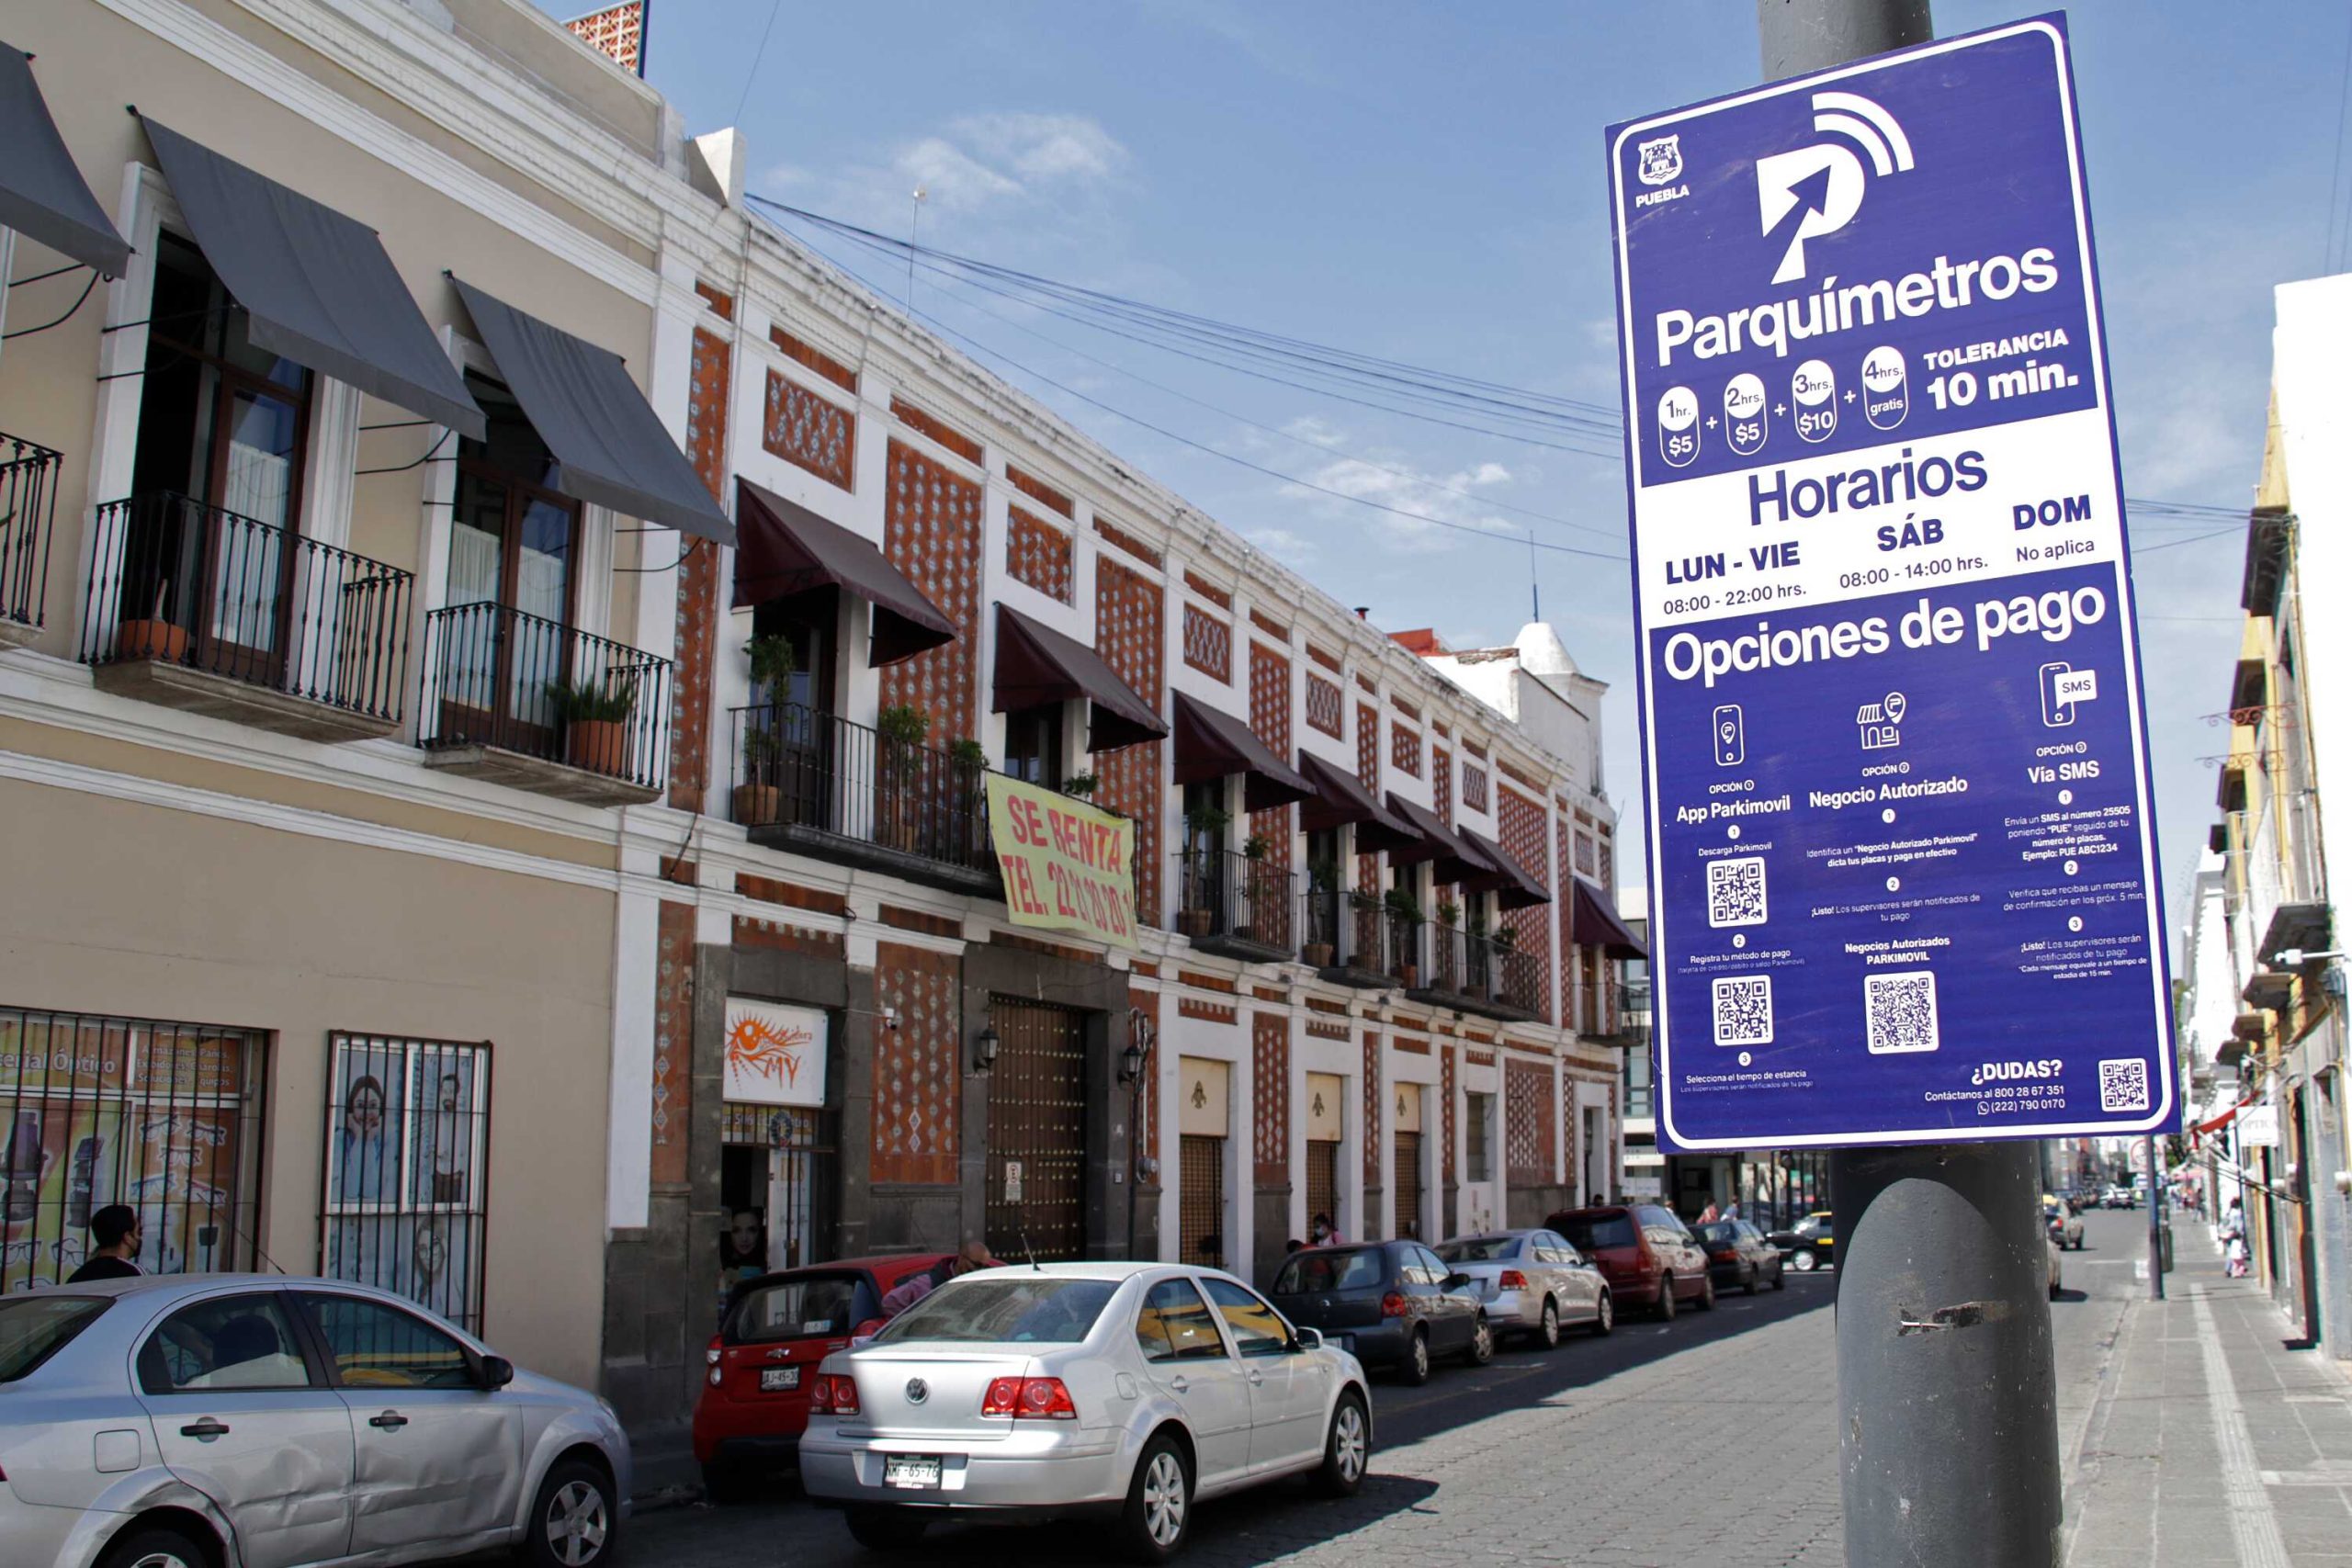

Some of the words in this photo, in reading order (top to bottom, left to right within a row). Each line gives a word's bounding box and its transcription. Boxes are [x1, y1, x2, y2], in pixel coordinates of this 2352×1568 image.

[1635, 185, 1690, 208] PUEBLA
[1657, 247, 2058, 367] Parquímetros
[1924, 329, 2068, 369] TOLERANCIA
[1865, 360, 1903, 379] 4hrs.
[1795, 374, 1832, 394] 3hrs.
[1927, 372, 1976, 410] 10
[1989, 360, 2078, 400] min.
[1727, 383, 1763, 407] 2hrs.
[1666, 400, 1690, 418] 1hr.
[1871, 399, 1903, 416] gratis
[1800, 412, 1833, 434] $10
[1736, 423, 1759, 443] $5
[1669, 436, 1692, 455] $5
[1749, 448, 1987, 525] Horarios
[2013, 495, 2091, 530] DOM
[1877, 513, 1943, 551] SÁB
[2017, 547, 2039, 562] No
[2045, 540, 2095, 561] aplica
[1667, 553, 1725, 584] LUN
[1750, 542, 1800, 571] VIE
[1839, 570, 1888, 589] 08:00
[1905, 559, 1951, 580] 14:00
[1958, 552, 1987, 570] hrs.
[1664, 597, 1710, 615] 08:00
[1725, 587, 1772, 606] 22:00
[1778, 579, 1806, 598] hrs.
[1665, 615, 1888, 687] Opciones
[1900, 599, 1962, 646] de
[1976, 586, 2105, 651] pago
[2062, 679, 2091, 693] SMS
[2036, 743, 2074, 757] OPCIÓN
[1862, 764, 1897, 776] OPCIÓN
[2028, 766, 2055, 784] Vía
[2059, 761, 2099, 780] SMS
[1709, 783, 1742, 794] OPCIÓN
[1809, 786, 1875, 809] Negocio
[1879, 776, 1967, 800] Autorizado
[1677, 807, 1707, 824] App
[1711, 795, 1790, 818] Parkimovil
[2041, 813, 2059, 822] SMS
[2062, 812, 2068, 820] al
[1008, 795, 1047, 847] SE
[1047, 808, 1122, 874] RENTA
[2008, 828, 2045, 839] poniendo
[2074, 821, 2106, 832] seguido
[2108, 819, 2118, 828] de
[1699, 848, 1732, 856] Descarga
[1735, 842, 1771, 852] Parkimovil
[1891, 839, 1931, 850] Autorizado
[2065, 835, 2075, 844] de
[1828, 858, 1846, 866] dicta
[1848, 856, 1860, 864] tus
[1861, 855, 1886, 865] placas
[1894, 853, 1913, 863] paga
[1926, 848, 1956, 858] efectivo
[2023, 850, 2058, 861] Ejemplo:
[2059, 848, 2076, 856] PUE
[2078, 843, 2118, 854] ABC1234
[2041, 888, 2056, 897] que
[2059, 884, 2088, 894] recibas
[2103, 880, 2138, 889] mensaje
[1837, 905, 1849, 913] Los
[1925, 896, 1968, 906] notificados
[2004, 903, 2014, 911] de
[2083, 896, 2095, 904] los
[2128, 892, 2144, 900] min.
[1881, 913, 1888, 921] tu
[1891, 912, 1910, 922] pago
[1845, 942, 1890, 954] Negocios
[1892, 937, 1950, 949] Autorizados
[2048, 941, 2063, 949] Los
[2064, 938, 2116, 948] supervisores
[1690, 955, 1720, 964] Registra
[1761, 951, 1770, 959] de
[1772, 950, 1791, 959] pago
[1867, 952, 1929, 964] PARKIMOVIL
[2036, 952, 2081, 962] notificados
[2083, 950, 2093, 958] de
[2096, 949, 2104, 957] tu
[2107, 948, 2127, 958] pago
[1687, 1075, 1726, 1084] Selecciona
[1736, 1072, 1762, 1082] tiempo
[1764, 1071, 1773, 1079] de
[1972, 1059, 2063, 1085] ¿DUDAS?
[1925, 1089, 1982, 1100] Contáctanos
[1984, 1089, 1993, 1098] al
[1995, 1088, 2014, 1097] 800
[2017, 1088, 2029, 1096] 28
[2031, 1087, 2043, 1096] 67
[2047, 1086, 2064, 1094] 351
[1991, 1100, 2017, 1112] (222)
[2019, 1100, 2039, 1110] 790
[2041, 1099, 2064, 1110] 0170
